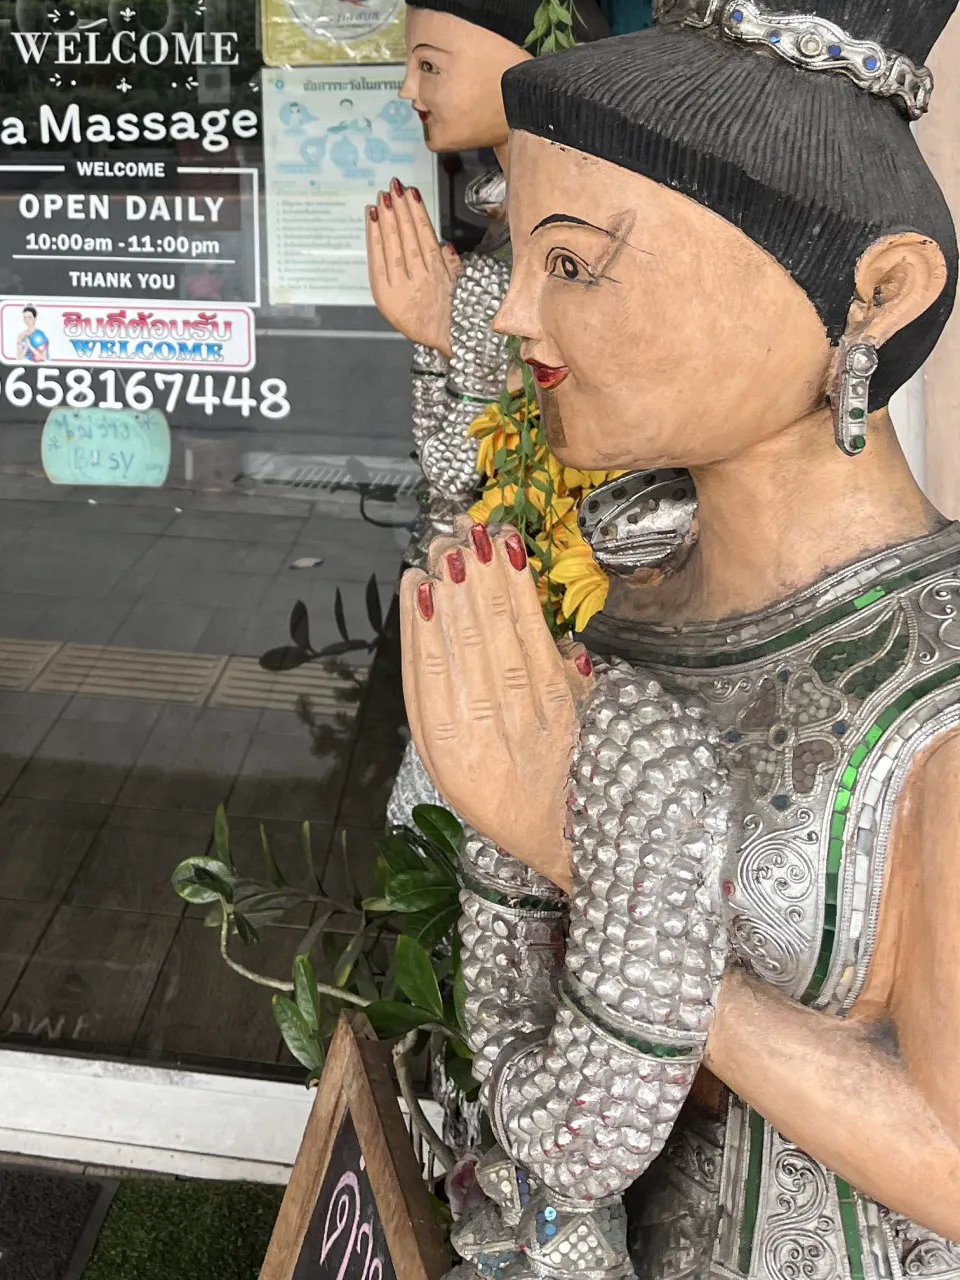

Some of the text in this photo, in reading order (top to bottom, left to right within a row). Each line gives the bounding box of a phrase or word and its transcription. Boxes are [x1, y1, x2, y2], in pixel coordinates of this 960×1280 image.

[11, 31, 239, 65] WELCOME
[39, 103, 258, 153] Massage
[77, 161, 166, 178] WELCOME
[18, 193, 224, 222] OPEN DAILY
[25, 233, 113, 253] 10:00am
[68, 271, 176, 290] THANK YOU
[62, 310, 233, 342] ยินดีต้อนรับ
[69, 339, 224, 362] WELCOME
